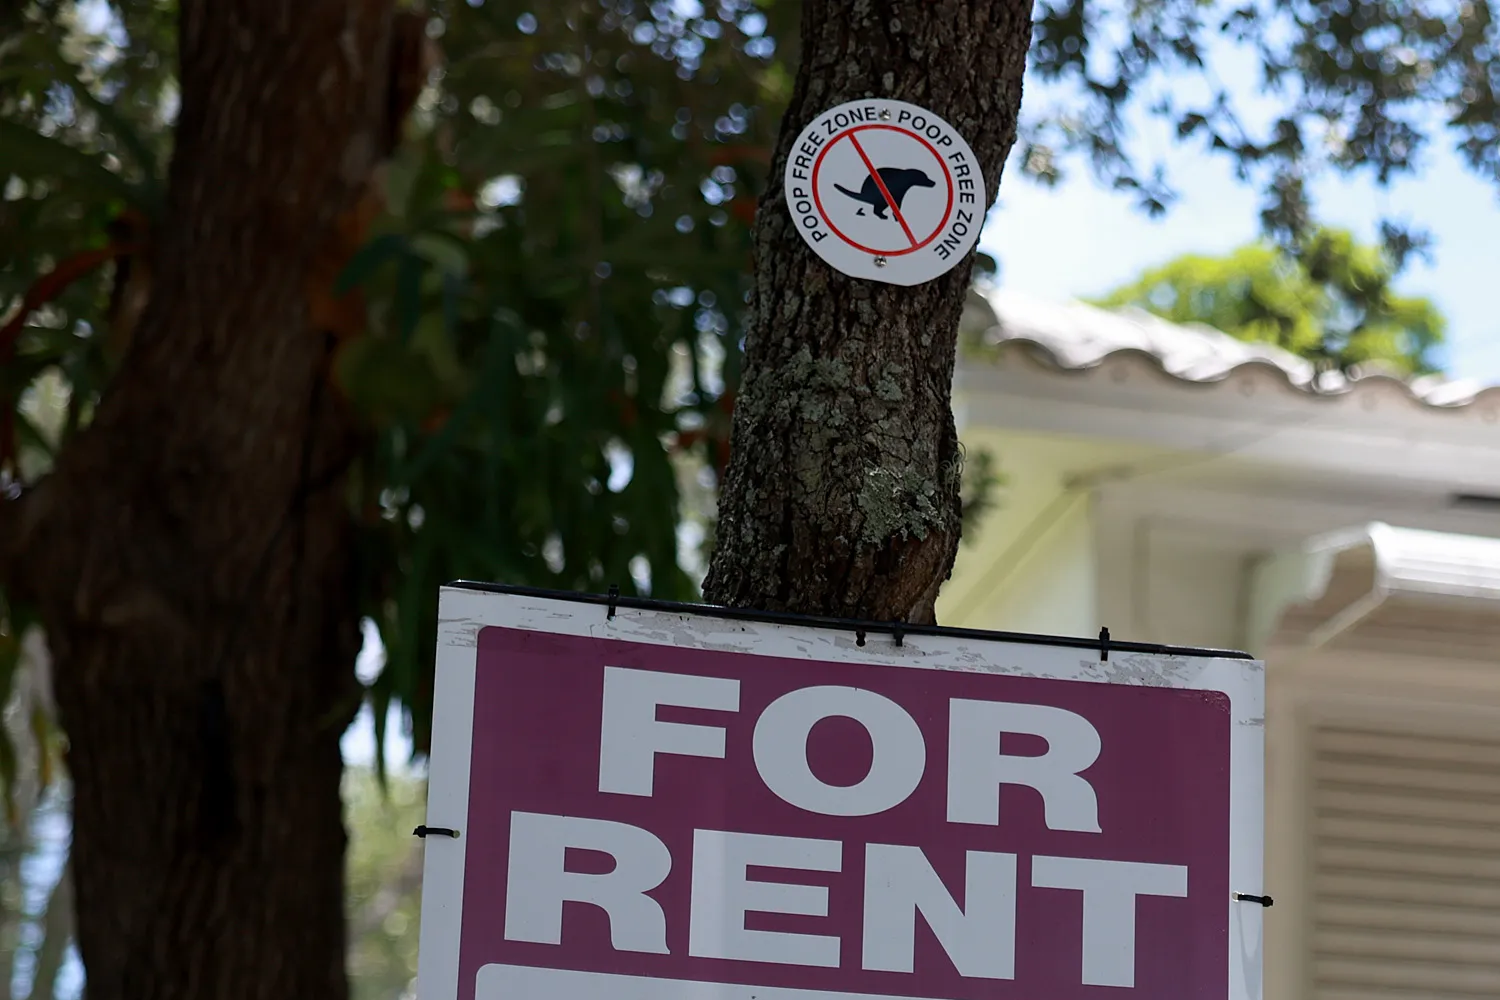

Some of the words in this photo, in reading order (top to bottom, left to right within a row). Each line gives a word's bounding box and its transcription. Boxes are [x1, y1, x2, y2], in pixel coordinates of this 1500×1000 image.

[822, 106, 878, 135] ZONE
[898, 110, 953, 147] POOP
[793, 131, 825, 180] FREE
[948, 152, 975, 204] FREE
[793, 187, 828, 243] POOP
[933, 209, 973, 260] ZONE
[598, 666, 1103, 834] FOR
[503, 811, 1188, 988] RENT
